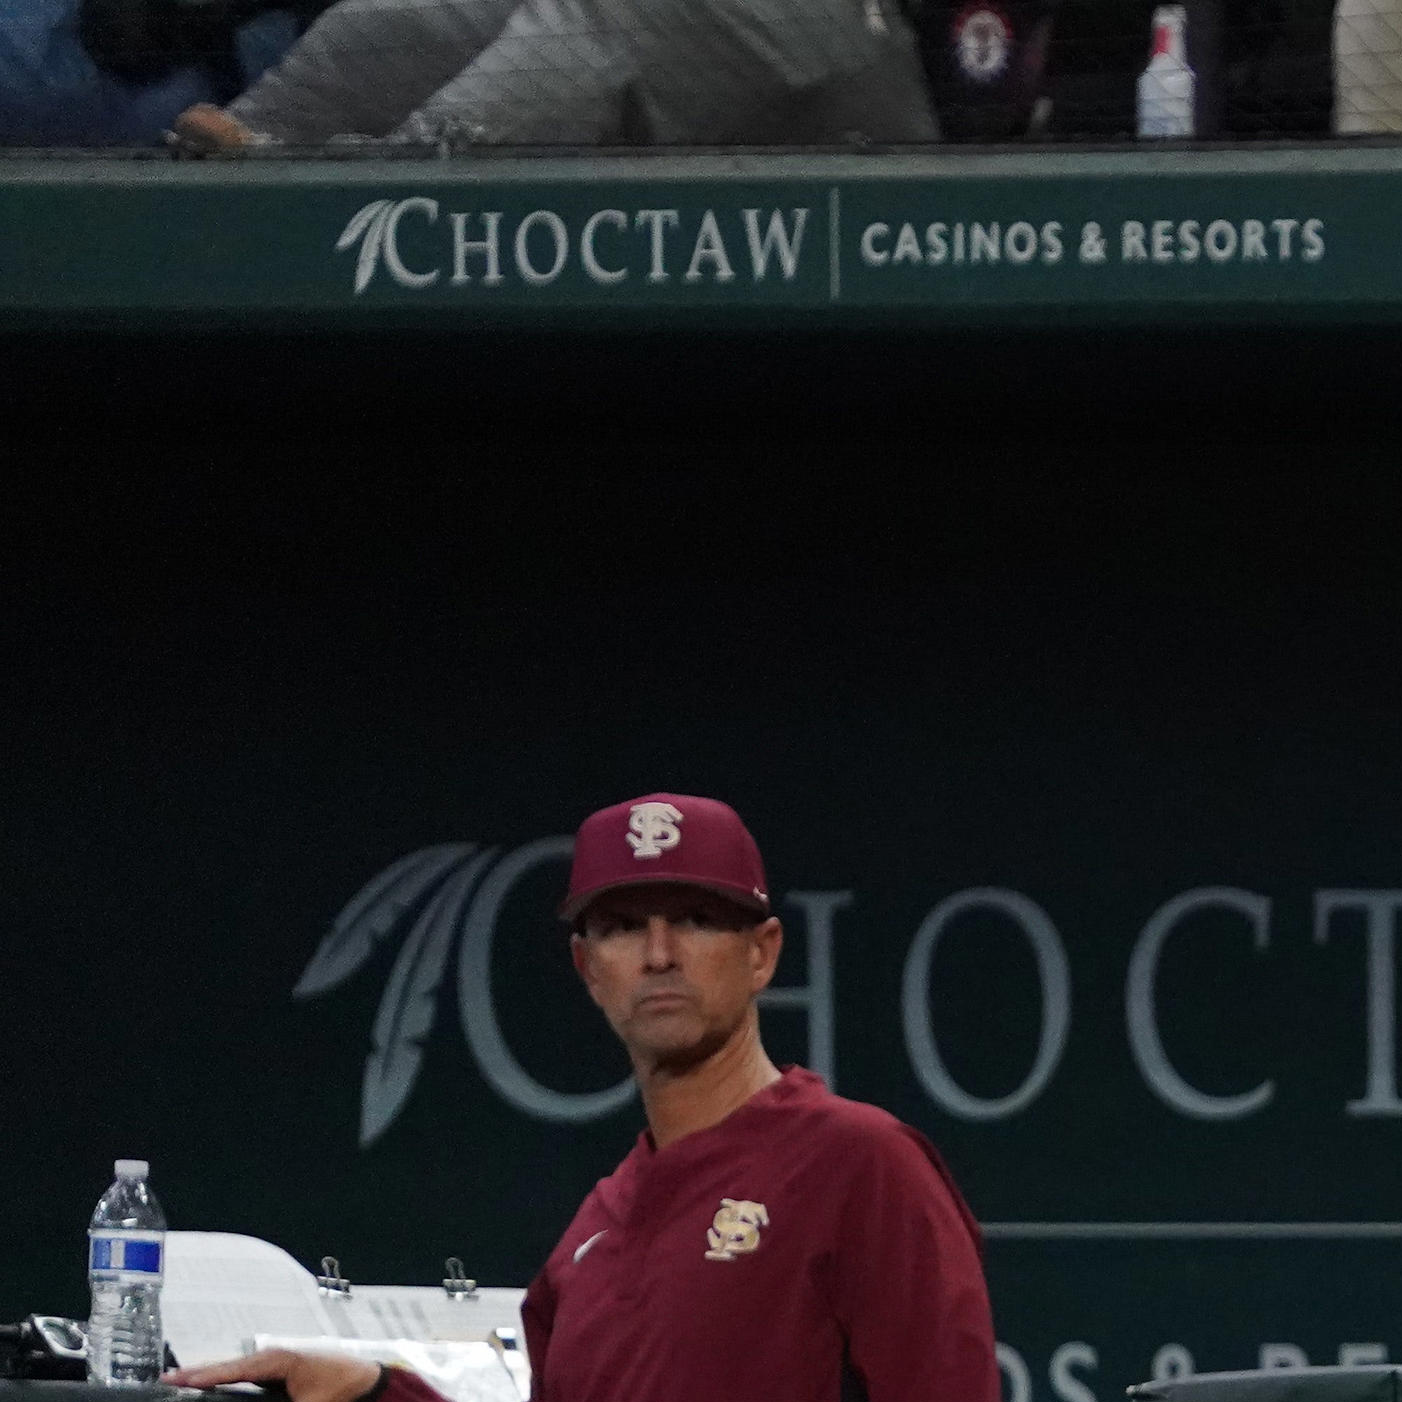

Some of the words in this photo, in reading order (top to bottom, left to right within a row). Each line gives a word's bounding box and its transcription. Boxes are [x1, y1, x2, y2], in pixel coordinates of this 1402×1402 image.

[383, 198, 808, 289] CHOCTAW
[862, 222, 1062, 265] CASINOS
[1080, 222, 1105, 262] &
[1122, 219, 1324, 262] RESORTS
